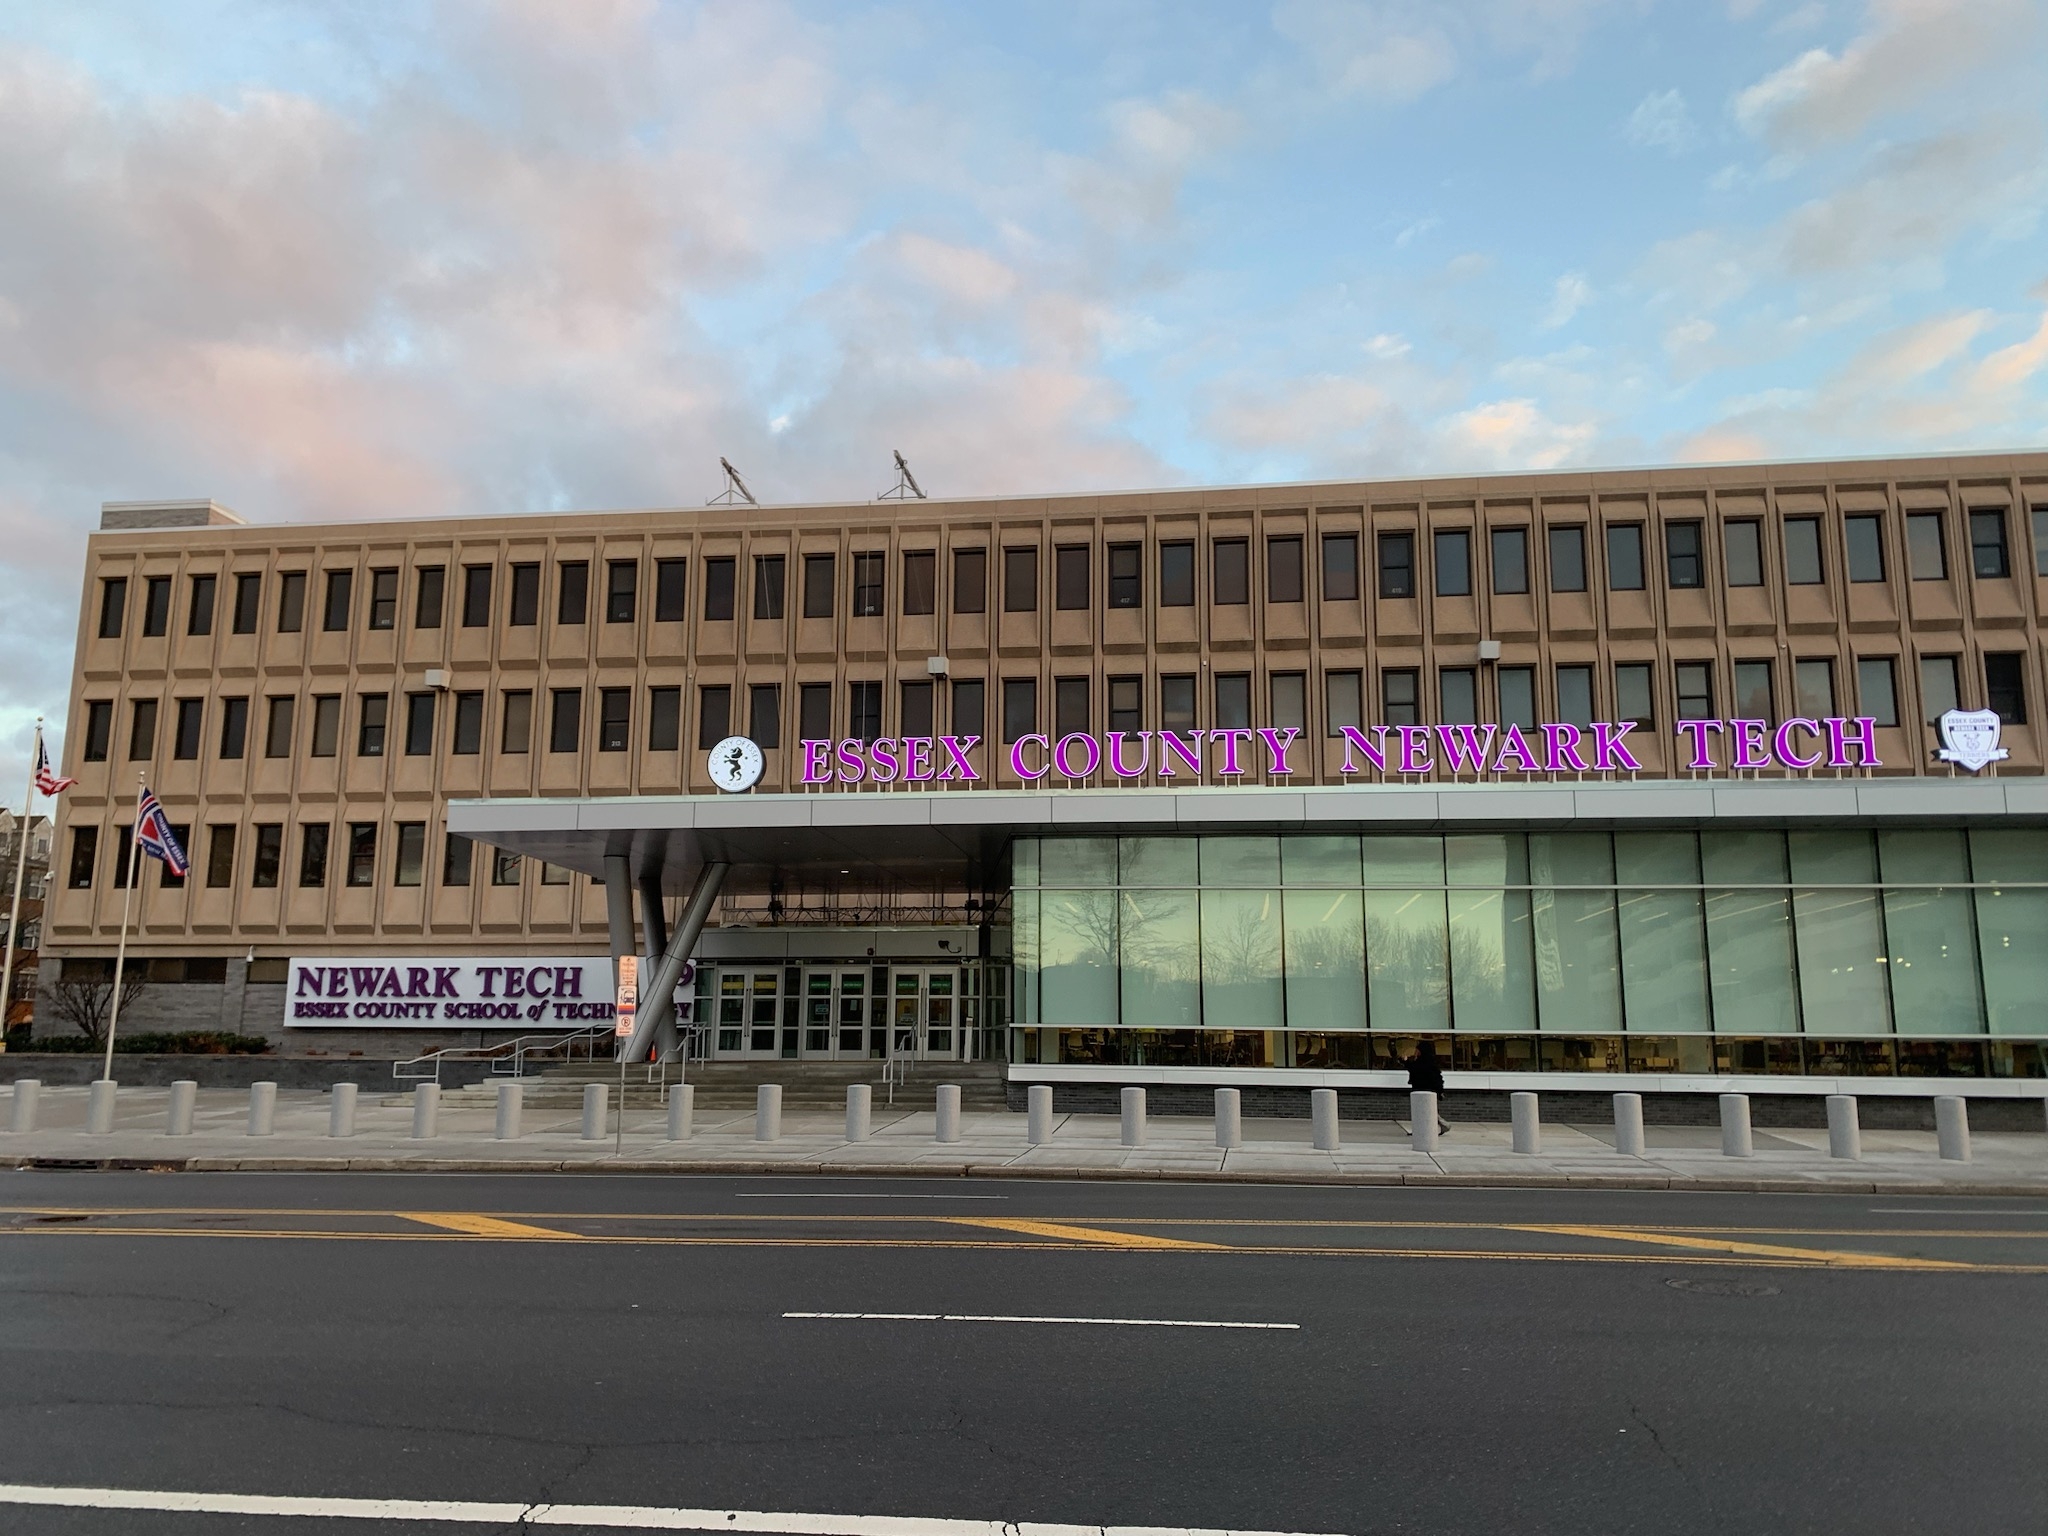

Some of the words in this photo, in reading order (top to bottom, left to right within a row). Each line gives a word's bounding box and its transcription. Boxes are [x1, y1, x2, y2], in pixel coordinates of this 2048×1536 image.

[711, 740, 733, 765] COUNTY
[745, 743, 759, 763] ESSEX
[800, 735, 981, 783] ESSEX
[1010, 728, 1300, 780] COUNTY
[1338, 721, 1643, 773] NEWARK
[1676, 717, 1883, 768] TECH
[157, 813, 172, 838] COUNTY
[171, 846, 186, 864] ESSEX
[295, 966, 460, 998] NEWARK
[475, 966, 583, 998] TECH
[293, 1002, 350, 1018] ESSEX
[353, 1002, 437, 1018] COUNTY
[444, 1002, 522, 1019] SCHOOL
[527, 999, 550, 1021] of
[552, 1002, 692, 1019] TECHNY
